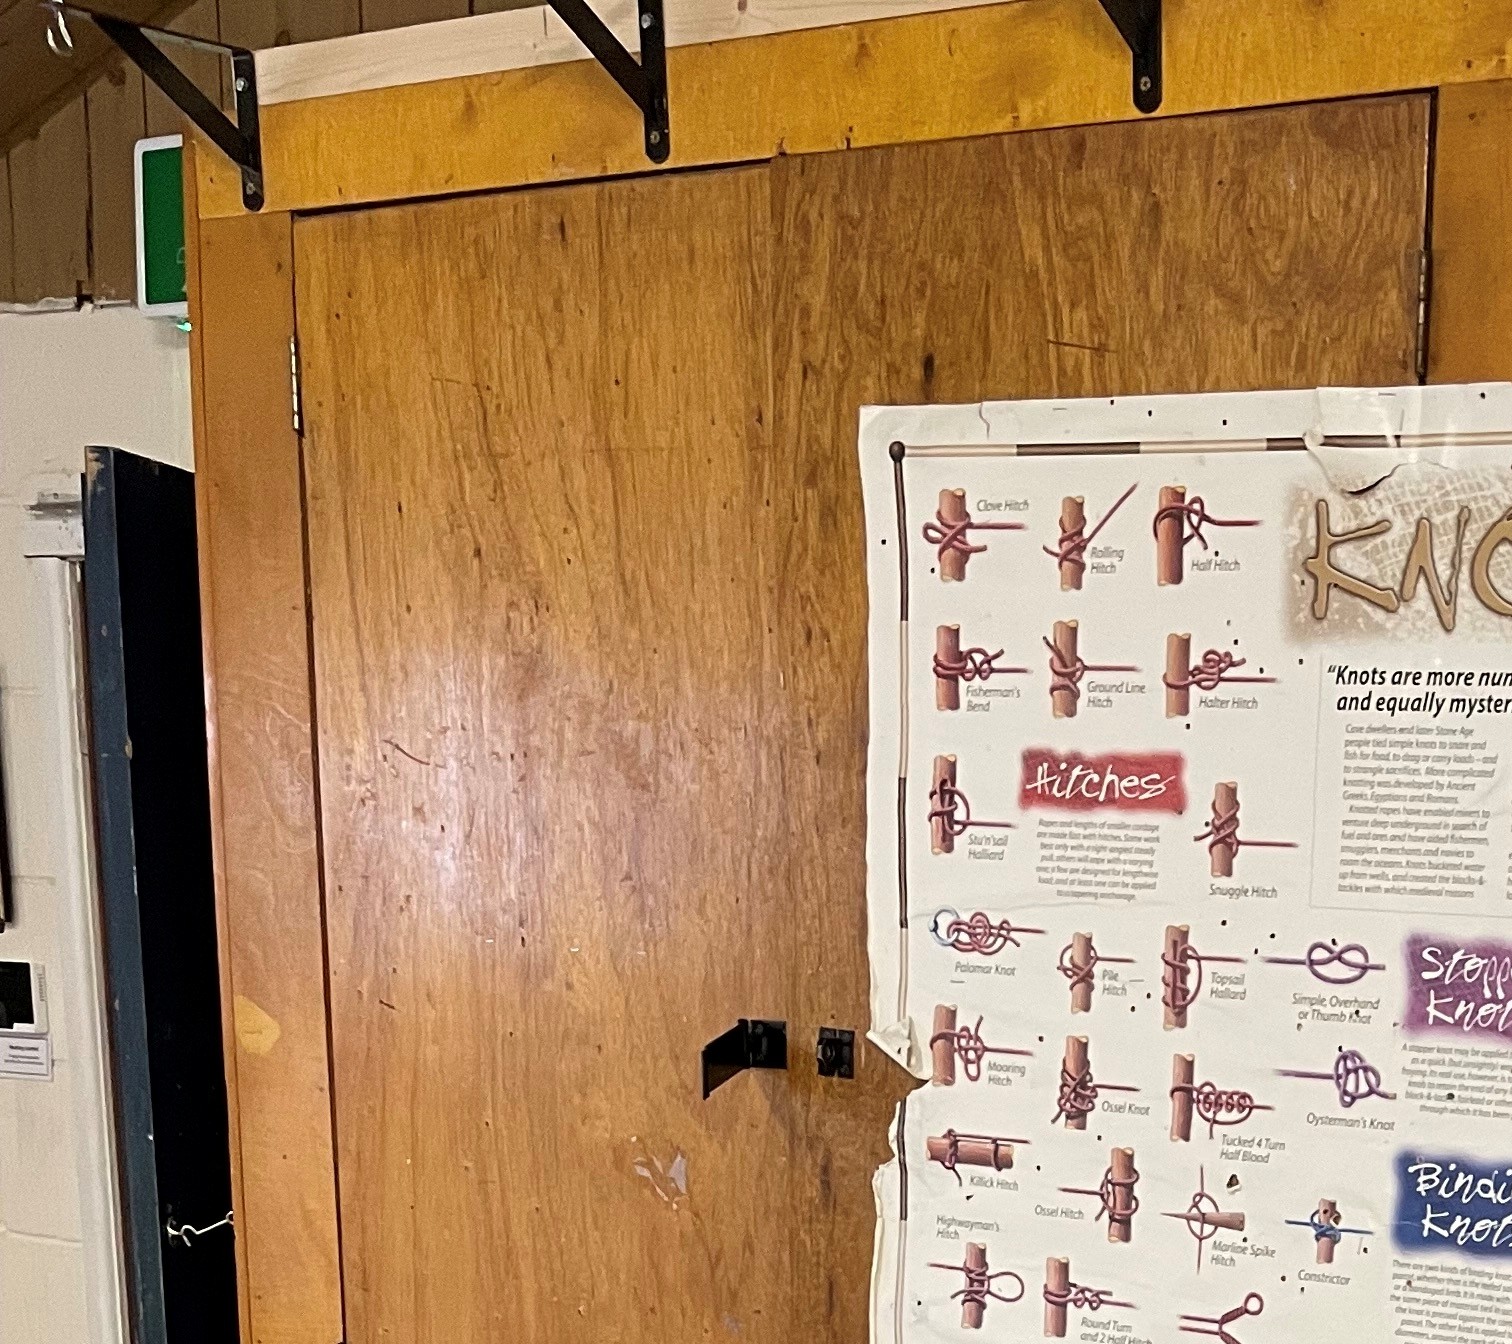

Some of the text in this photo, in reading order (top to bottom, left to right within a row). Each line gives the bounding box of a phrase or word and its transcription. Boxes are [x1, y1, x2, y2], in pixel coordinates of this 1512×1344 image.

[978, 500, 1029, 511] Clove Hitch
[1192, 560, 1240, 571] Half Hitch
[1390, 669, 1422, 686] are
[1427, 670, 1475, 687] more
[1336, 692, 1372, 712] and
[1376, 693, 1446, 717] equally
[1026, 762, 1176, 801] Hitches
[1209, 884, 1277, 898] Snuggle Hitch
[1307, 1113, 1395, 1131] Oysterman's Knot
[999, 1178, 1018, 1191] Hitch
[1035, 1206, 1084, 1219] Ossel Hitch
[937, 1215, 999, 1232] Highwayman's
[937, 1227, 959, 1239] Hitch
[1298, 1269, 1351, 1286] Constrictor
[1081, 1317, 1132, 1333] Round Turn
[1080, 1332, 1097, 1342] and
[1099, 1334, 1105, 1343] 2
